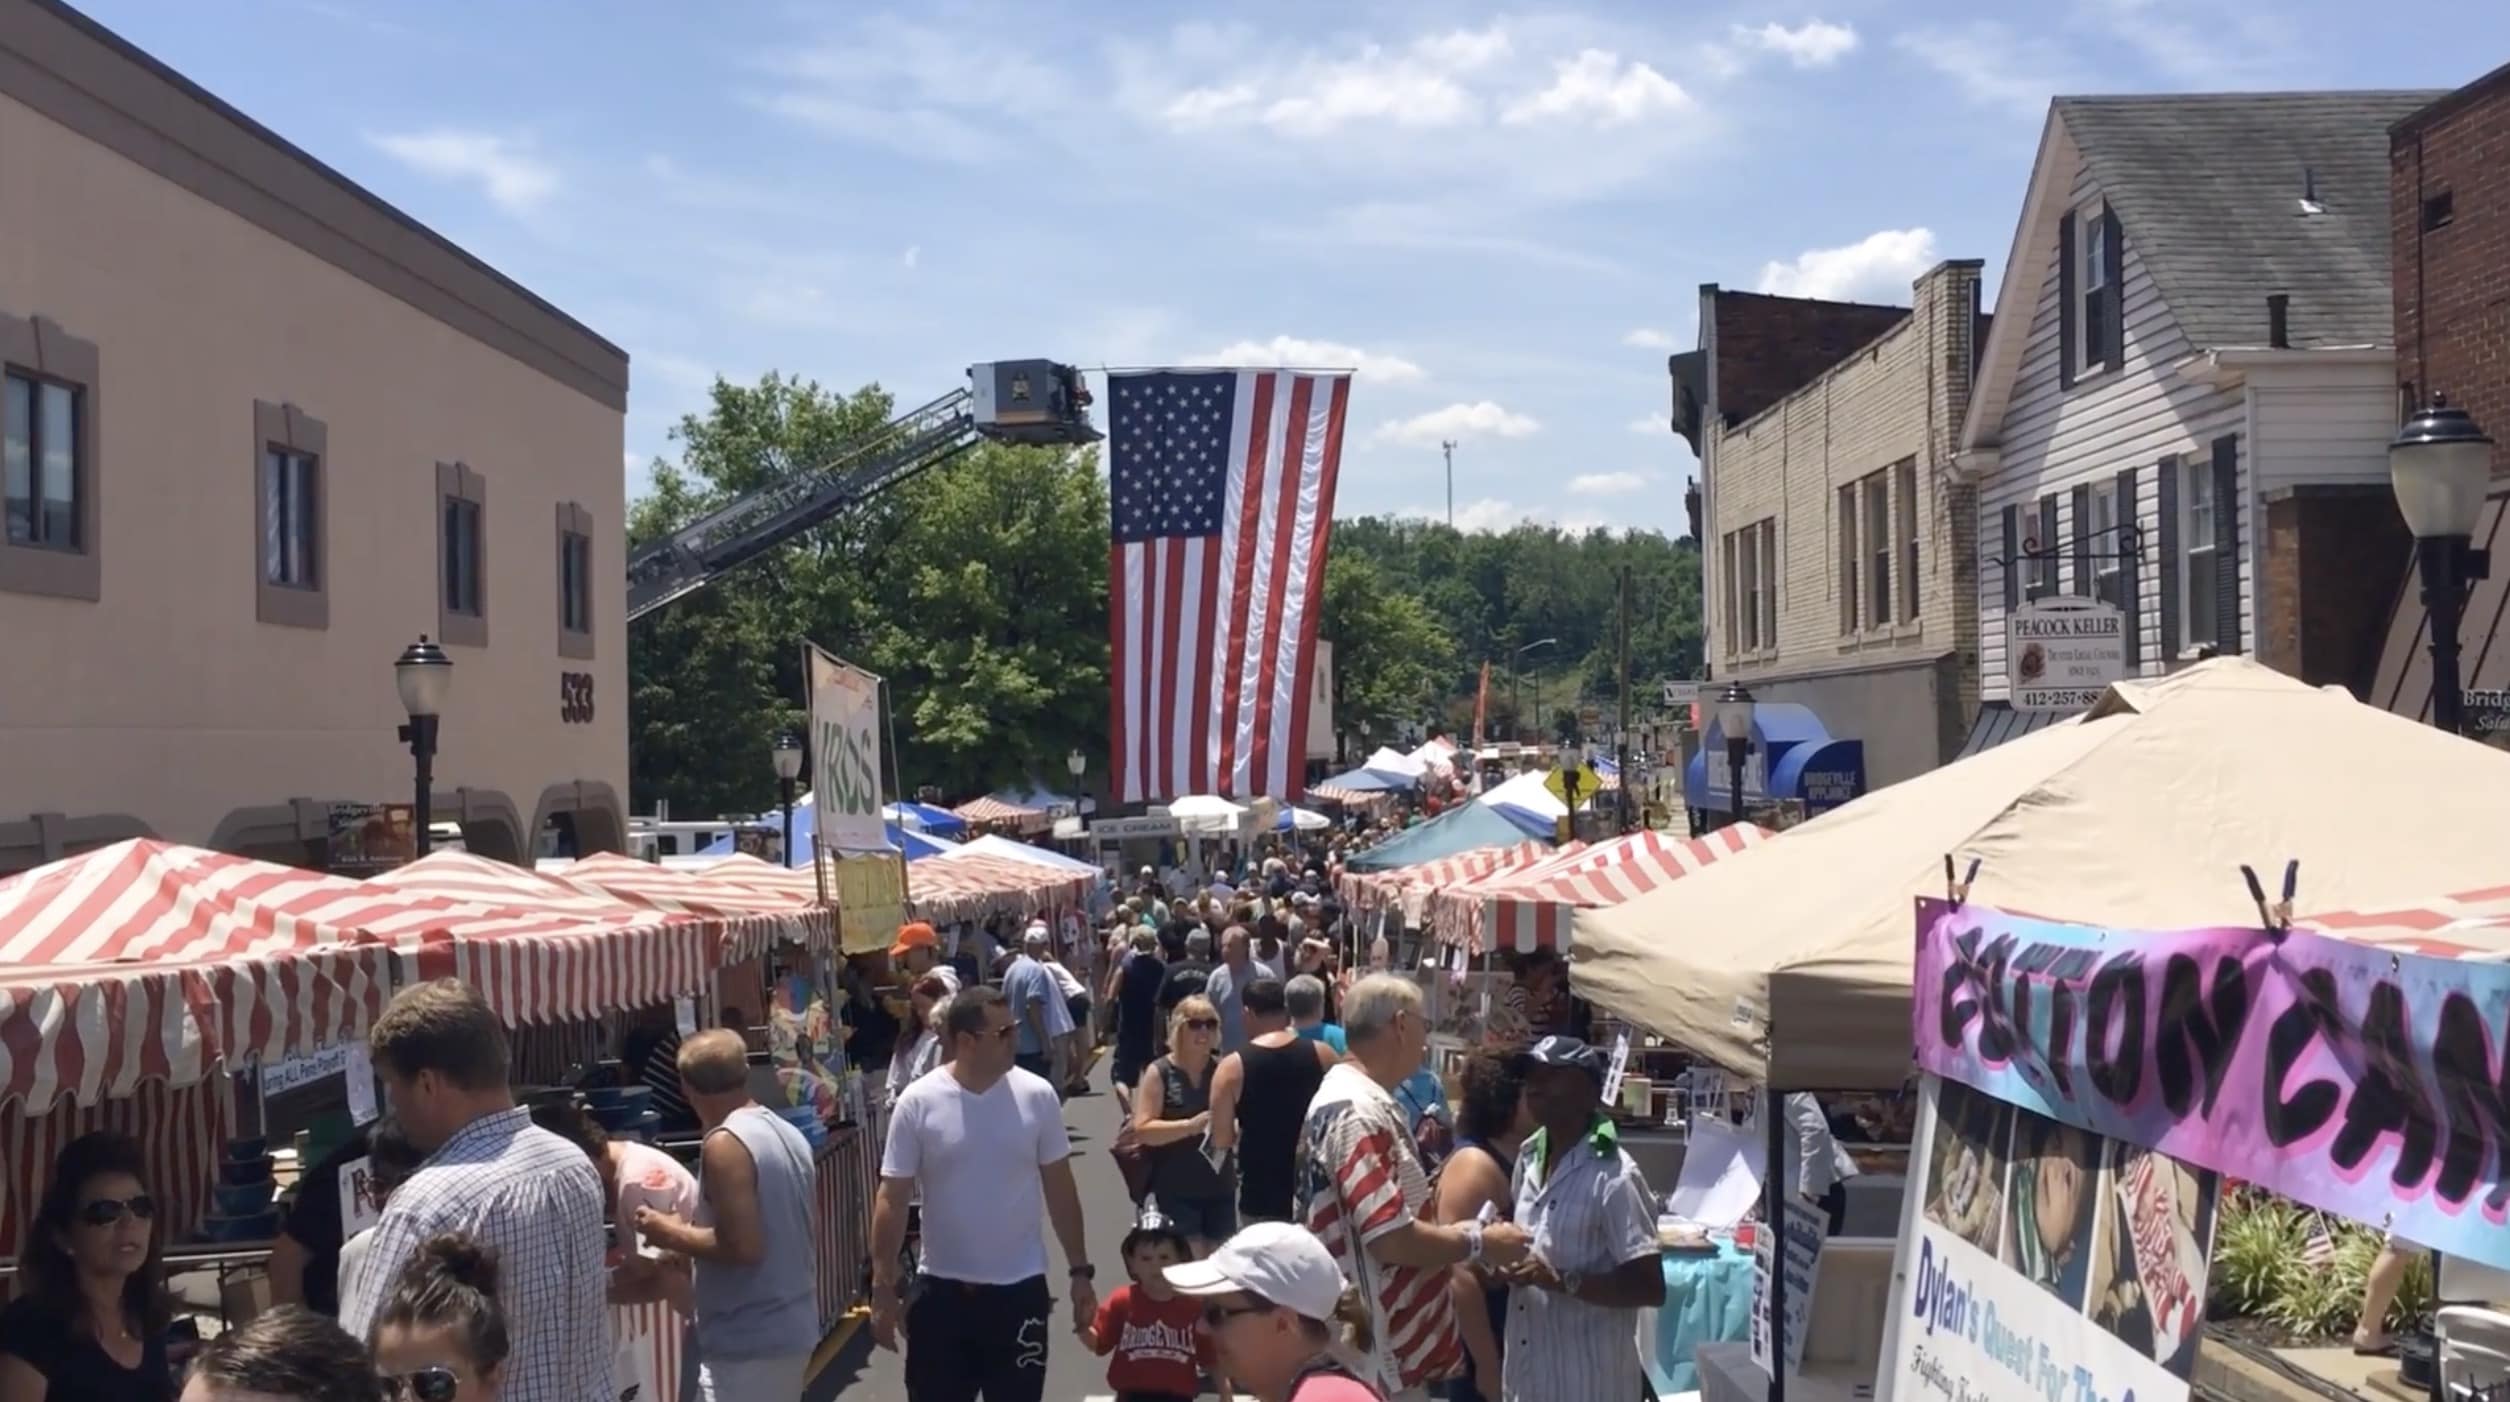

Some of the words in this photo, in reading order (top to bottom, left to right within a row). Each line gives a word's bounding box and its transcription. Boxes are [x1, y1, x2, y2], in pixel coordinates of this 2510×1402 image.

[2015, 619, 2070, 636] PEACOCK
[2073, 617, 2119, 635] KELLER
[561, 671, 595, 724] 533
[1123, 822, 1172, 833] CREAM
[1119, 1317, 1197, 1354] BRIDGEVILLE
[1913, 1235, 1979, 1344] Dylan's
[1983, 1300, 2033, 1384] Quest
[2072, 1364, 2108, 1402] Th
